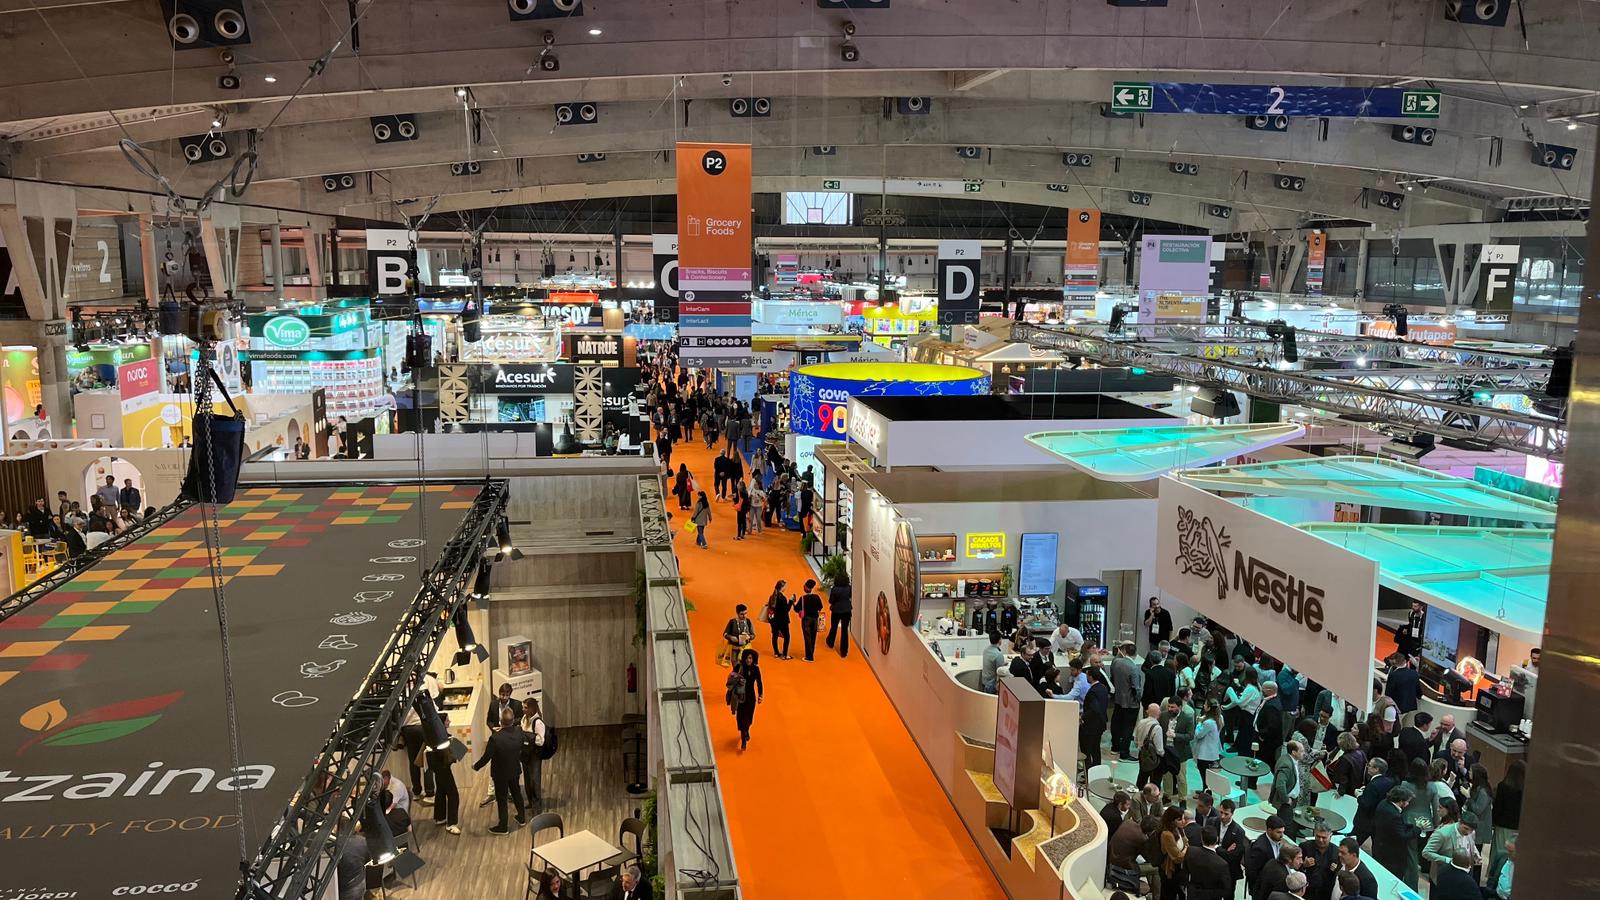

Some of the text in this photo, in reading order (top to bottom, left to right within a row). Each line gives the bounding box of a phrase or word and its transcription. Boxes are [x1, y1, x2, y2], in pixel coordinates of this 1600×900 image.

[1268, 87, 1285, 114] 2
[706, 158, 723, 169] P2
[706, 217, 742, 229] Grocery
[706, 227, 735, 235] Foods
[97, 240, 112, 283] 2
[377, 256, 408, 294] B
[945, 265, 975, 301] D
[1487, 268, 1510, 301] F
[788, 309, 818, 317] Mérica
[944, 311, 973, 323] C E
[266, 324, 302, 338] Vima
[1408, 329, 1454, 341] frutapac
[577, 341, 618, 355] NATRUE
[751, 355, 773, 365] érica
[495, 369, 547, 383] Acesur
[818, 388, 850, 401] GOYA
[818, 404, 848, 434] 90
